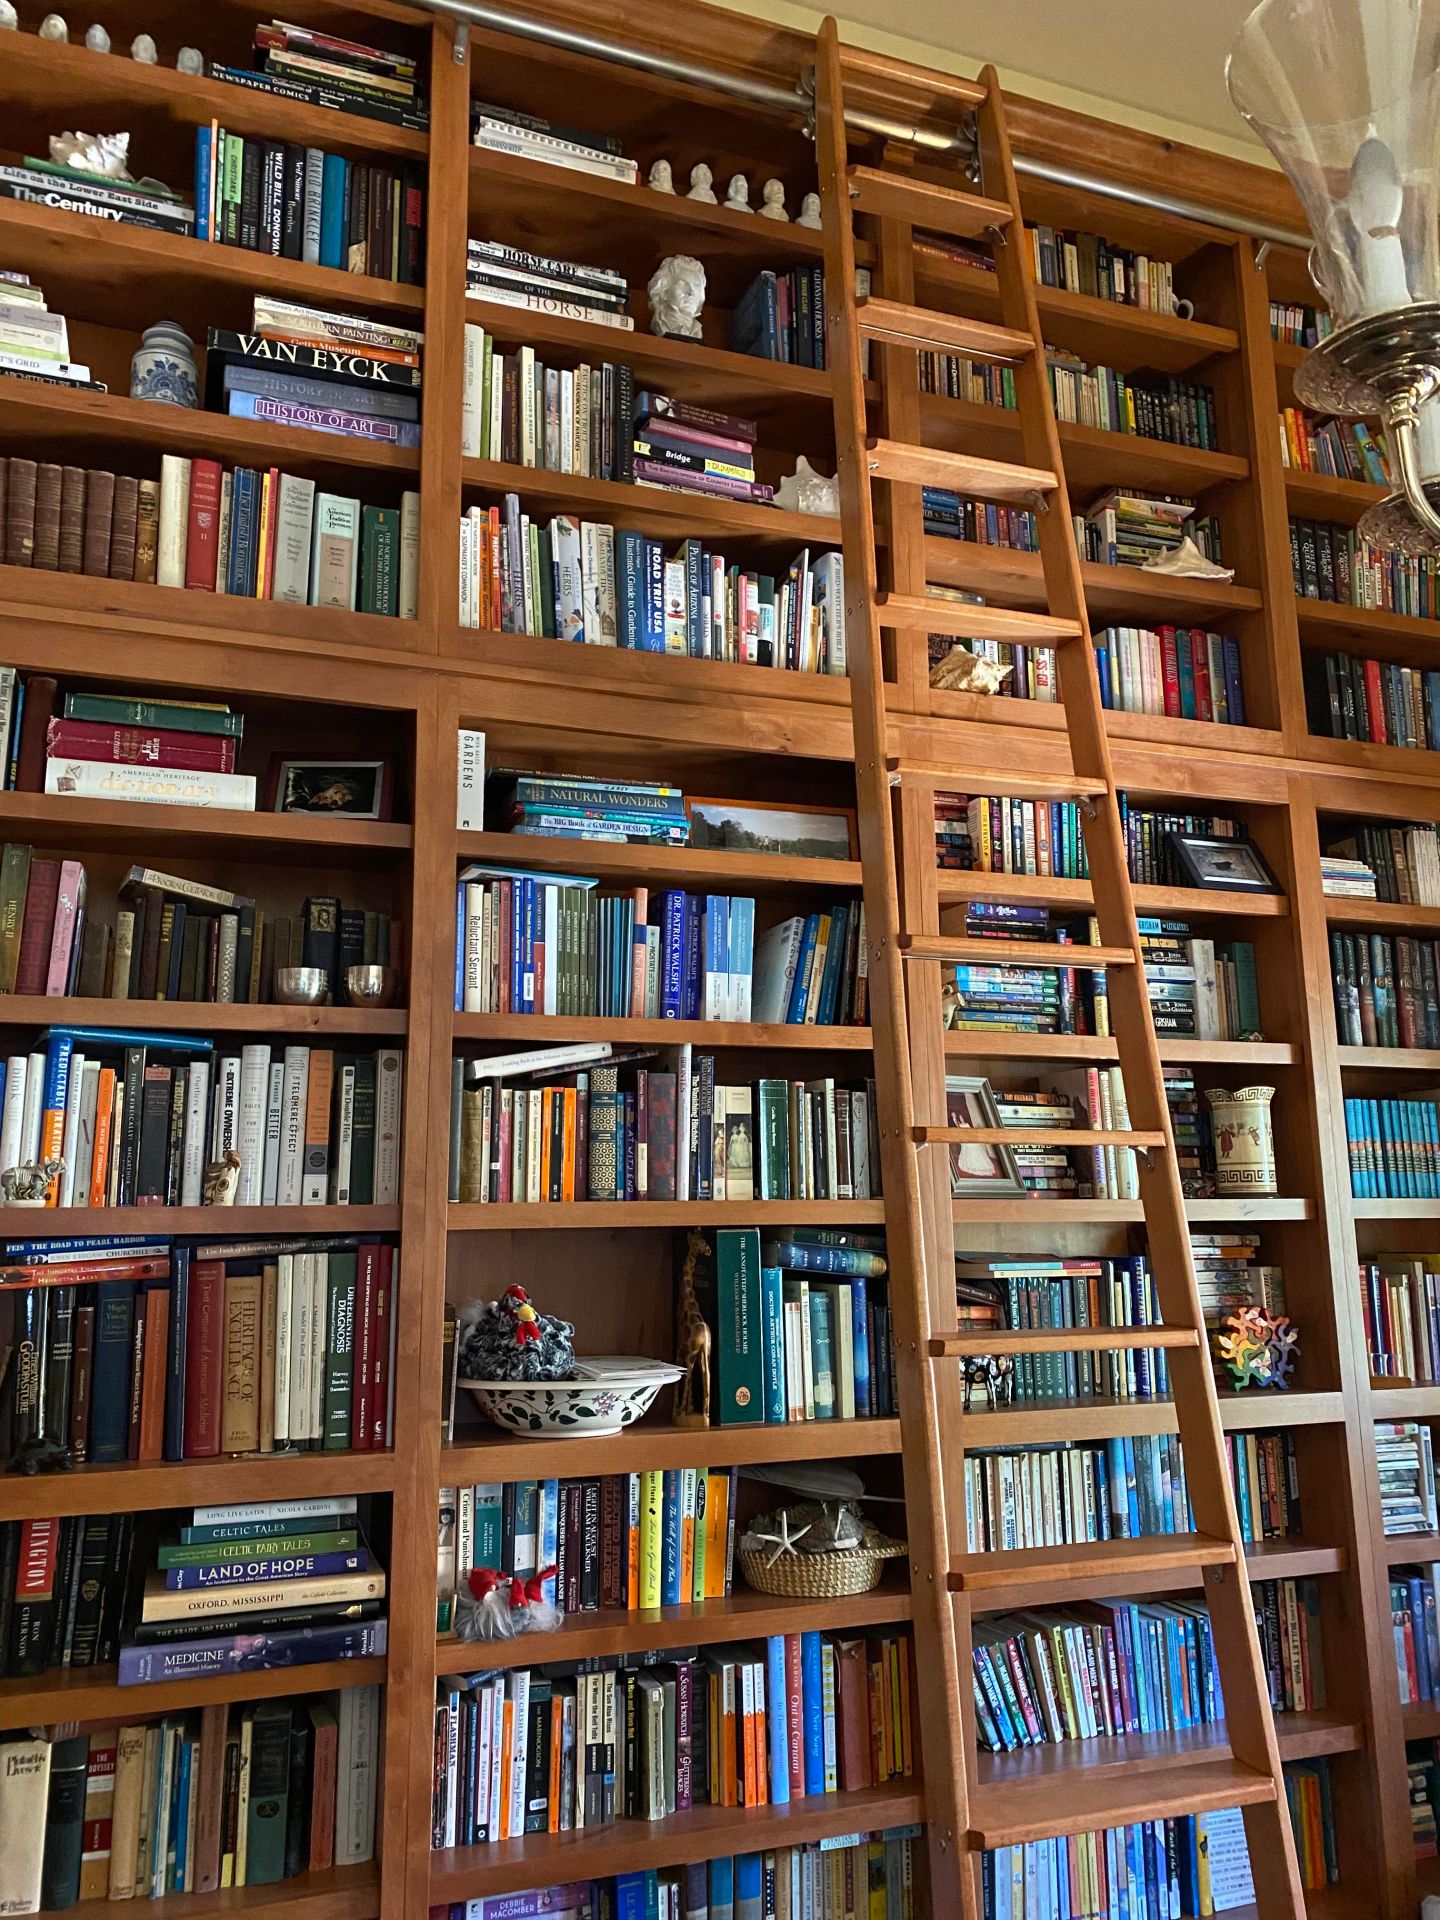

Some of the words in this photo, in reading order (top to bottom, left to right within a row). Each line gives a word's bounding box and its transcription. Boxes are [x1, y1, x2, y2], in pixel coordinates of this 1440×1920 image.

[212, 71, 271, 91] NEWSPAPER
[273, 87, 310, 101] COMICS
[273, 152, 283, 180] WILD
[307, 154, 323, 187] DAVID
[3, 168, 28, 181] Life
[30, 173, 45, 185] on
[47, 177, 66, 189] the
[69, 182, 105, 198] Lower
[107, 191, 133, 204] East
[134, 198, 159, 210] Side
[272, 181, 282, 205] BILL
[11, 184, 46, 203] The
[45, 192, 124, 222] Century
[287, 200, 297, 233] Rewrites
[305, 190, 321, 244] BRINKLEY
[271, 208, 281, 256] DONOVAN
[503, 247, 545, 266] HORSE
[544, 258, 579, 276] CARE
[527, 294, 594, 321] HORSE
[290, 338, 317, 351] Getty
[318, 341, 362, 357] Museum
[342, 327, 387, 345] PAINTING
[16, 357, 41, 369] GRID
[236, 333, 299, 364] VAN
[311, 348, 391, 382] EYCK
[266, 401, 324, 424] HISTORY
[328, 414, 347, 428] OF
[349, 417, 376, 433] ART
[665, 450, 692, 464] Bridge
[461, 535, 469, 570] SOAPMAKER'S
[626, 537, 636, 574] Illustrated
[653, 547, 662, 579] ROAD
[689, 546, 700, 573] PLANTS
[1303, 543, 1312, 571] QUEEN
[1308, 543, 1317, 572] EXILED
[1338, 552, 1346, 578] CROWN
[460, 571, 469, 603] COMPANION
[513, 570, 523, 608] HERBS
[562, 566, 572, 597] HERBS
[627, 575, 637, 599] Guide
[689, 575, 698, 585] OF
[653, 583, 662, 608] TRIP
[689, 586, 700, 619] ARIZONA
[625, 609, 637, 650] Gardening
[653, 611, 662, 634] USA
[1036, 658, 1048, 687] SS-GB
[1165, 650, 1179, 683] FRANCIS
[121, 769, 162, 780] AMERICAN
[163, 773, 201, 782] HERITAGE
[462, 735, 474, 789] GARDENS
[550, 787, 606, 804] NATURAL
[607, 793, 669, 809] WONDERS
[1012, 807, 1021, 826] NERVE
[982, 828, 990, 851] FRANCIS
[6, 900, 17, 929] HENRY
[673, 895, 682, 910] DR.
[468, 915, 481, 955] Reluctant
[671, 912, 681, 950] PATRICK
[1138, 920, 1160, 929] GRISHAM
[1166, 922, 1190, 932] LITIGATORS
[648, 945, 657, 972] PROSTATE
[468, 957, 480, 989] Servant
[670, 953, 680, 992] WALSH'S
[1155, 1017, 1178, 1028] GRISHAM
[9, 1067, 24, 1101] blink
[129, 1073, 137, 1095] THINK
[174, 1080, 186, 1114] TRUMP
[192, 1076, 202, 1107] Outliers
[344, 1083, 353, 1097] The
[289, 1081, 301, 1122] TELOMERE
[343, 1099, 352, 1123] Double
[287, 1124, 298, 1153] EFFECT
[342, 1123, 351, 1143] Helix
[124, 1146, 133, 1185] MACARTHUR
[7, 1243, 25, 1252] FEIS
[31, 1242, 48, 1250] THE
[50, 1241, 72, 1249] ROAD
[86, 1238, 112, 1247] PEARL
[113, 1236, 146, 1244] HARBOR
[106, 1248, 149, 1257] CHURCHILL
[739, 1237, 747, 1249] THE
[740, 1251, 748, 1290] ANNOTATED
[1077, 1279, 1086, 1312] EDINBURGH
[241, 1300, 256, 1377] HERITAGE
[336, 1299, 346, 1354] DIAGNOSIS
[18, 1340, 34, 1414] GOODPASTURE
[241, 1383, 255, 1403] OF
[462, 1493, 471, 1517] Crime
[590, 1487, 598, 1511] LIGHT
[213, 1526, 250, 1538] CELTIC
[254, 1523, 286, 1534] TALES
[462, 1519, 470, 1533] and
[590, 1512, 597, 1522] IN
[223, 1545, 254, 1557] CELTIC
[256, 1542, 280, 1554] FAIRY
[280, 1539, 311, 1552] TALES
[461, 1535, 470, 1580] Punishment
[584, 1527, 592, 1573] FAULKNER
[199, 1565, 244, 1581] LAND
[247, 1562, 268, 1575] OF
[271, 1558, 315, 1573] HOPE
[188, 1598, 231, 1611] OXFORD,
[232, 1593, 285, 1606] MISSISSIPPI
[18, 1606, 31, 1658] CHERNOW
[31, 1621, 41, 1642] RON
[1290, 1622, 1300, 1656] BULLET
[164, 1649, 224, 1667] MEDICINE
[1086, 1648, 1096, 1666] NGAIO
[1108, 1650, 1118, 1669] NGAIO
[1088, 1666, 1098, 1687] MARSH
[1110, 1669, 1120, 1690] MARSH
[1293, 1658, 1303, 1684] TRAIN
[518, 1676, 526, 1700] JOHN
[679, 1675, 690, 1700] SUSAN
[1003, 1683, 1014, 1703] MARSH
[790, 1694, 800, 1715] Out
[517, 1702, 525, 1743] GRISHAM
[679, 1701, 689, 1737] HOWATCH
[791, 1718, 799, 1728] to
[449, 1715, 458, 1768] FLASHMAN
[535, 1716, 543, 1768] MABINOGION
[791, 1731, 801, 1774] Canaan
[682, 1757, 691, 1798] GLITTERING
[490, 1903, 535, 1920] MACOMBER
[499, 1897, 525, 1910] DEBBIE
